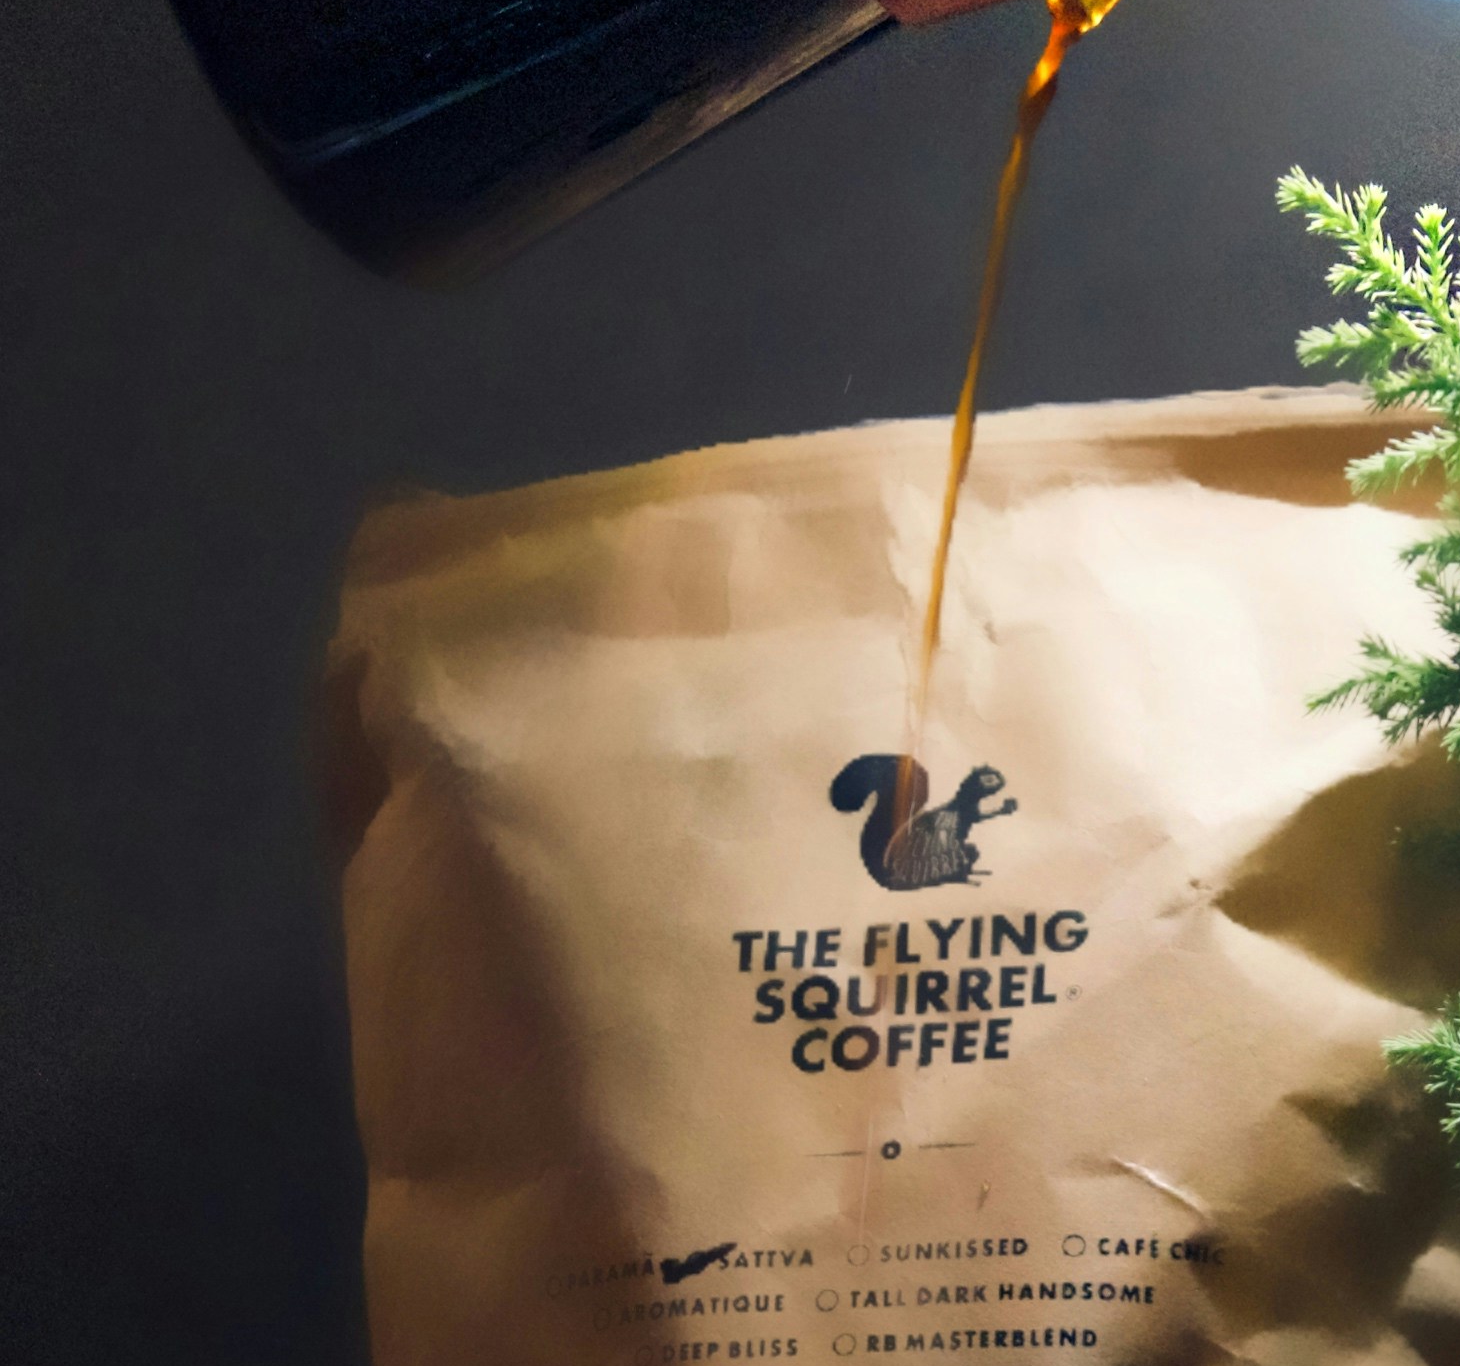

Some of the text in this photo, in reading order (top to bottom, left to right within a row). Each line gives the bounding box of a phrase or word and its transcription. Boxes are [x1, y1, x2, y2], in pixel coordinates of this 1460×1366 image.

[732, 909, 1089, 972] THE FLYING
[753, 963, 1057, 1024] SQUIRREL
[791, 1018, 1012, 1073] COFFEE
[880, 1237, 1029, 1263] SUNKISSED
[619, 1293, 786, 1325] AROMATIQUE
[850, 1282, 1156, 1308] TALL DARK HANDSOME
[662, 1337, 799, 1363] DEEP BLISS
[866, 1329, 1098, 1352] RB MASTERBLEND
